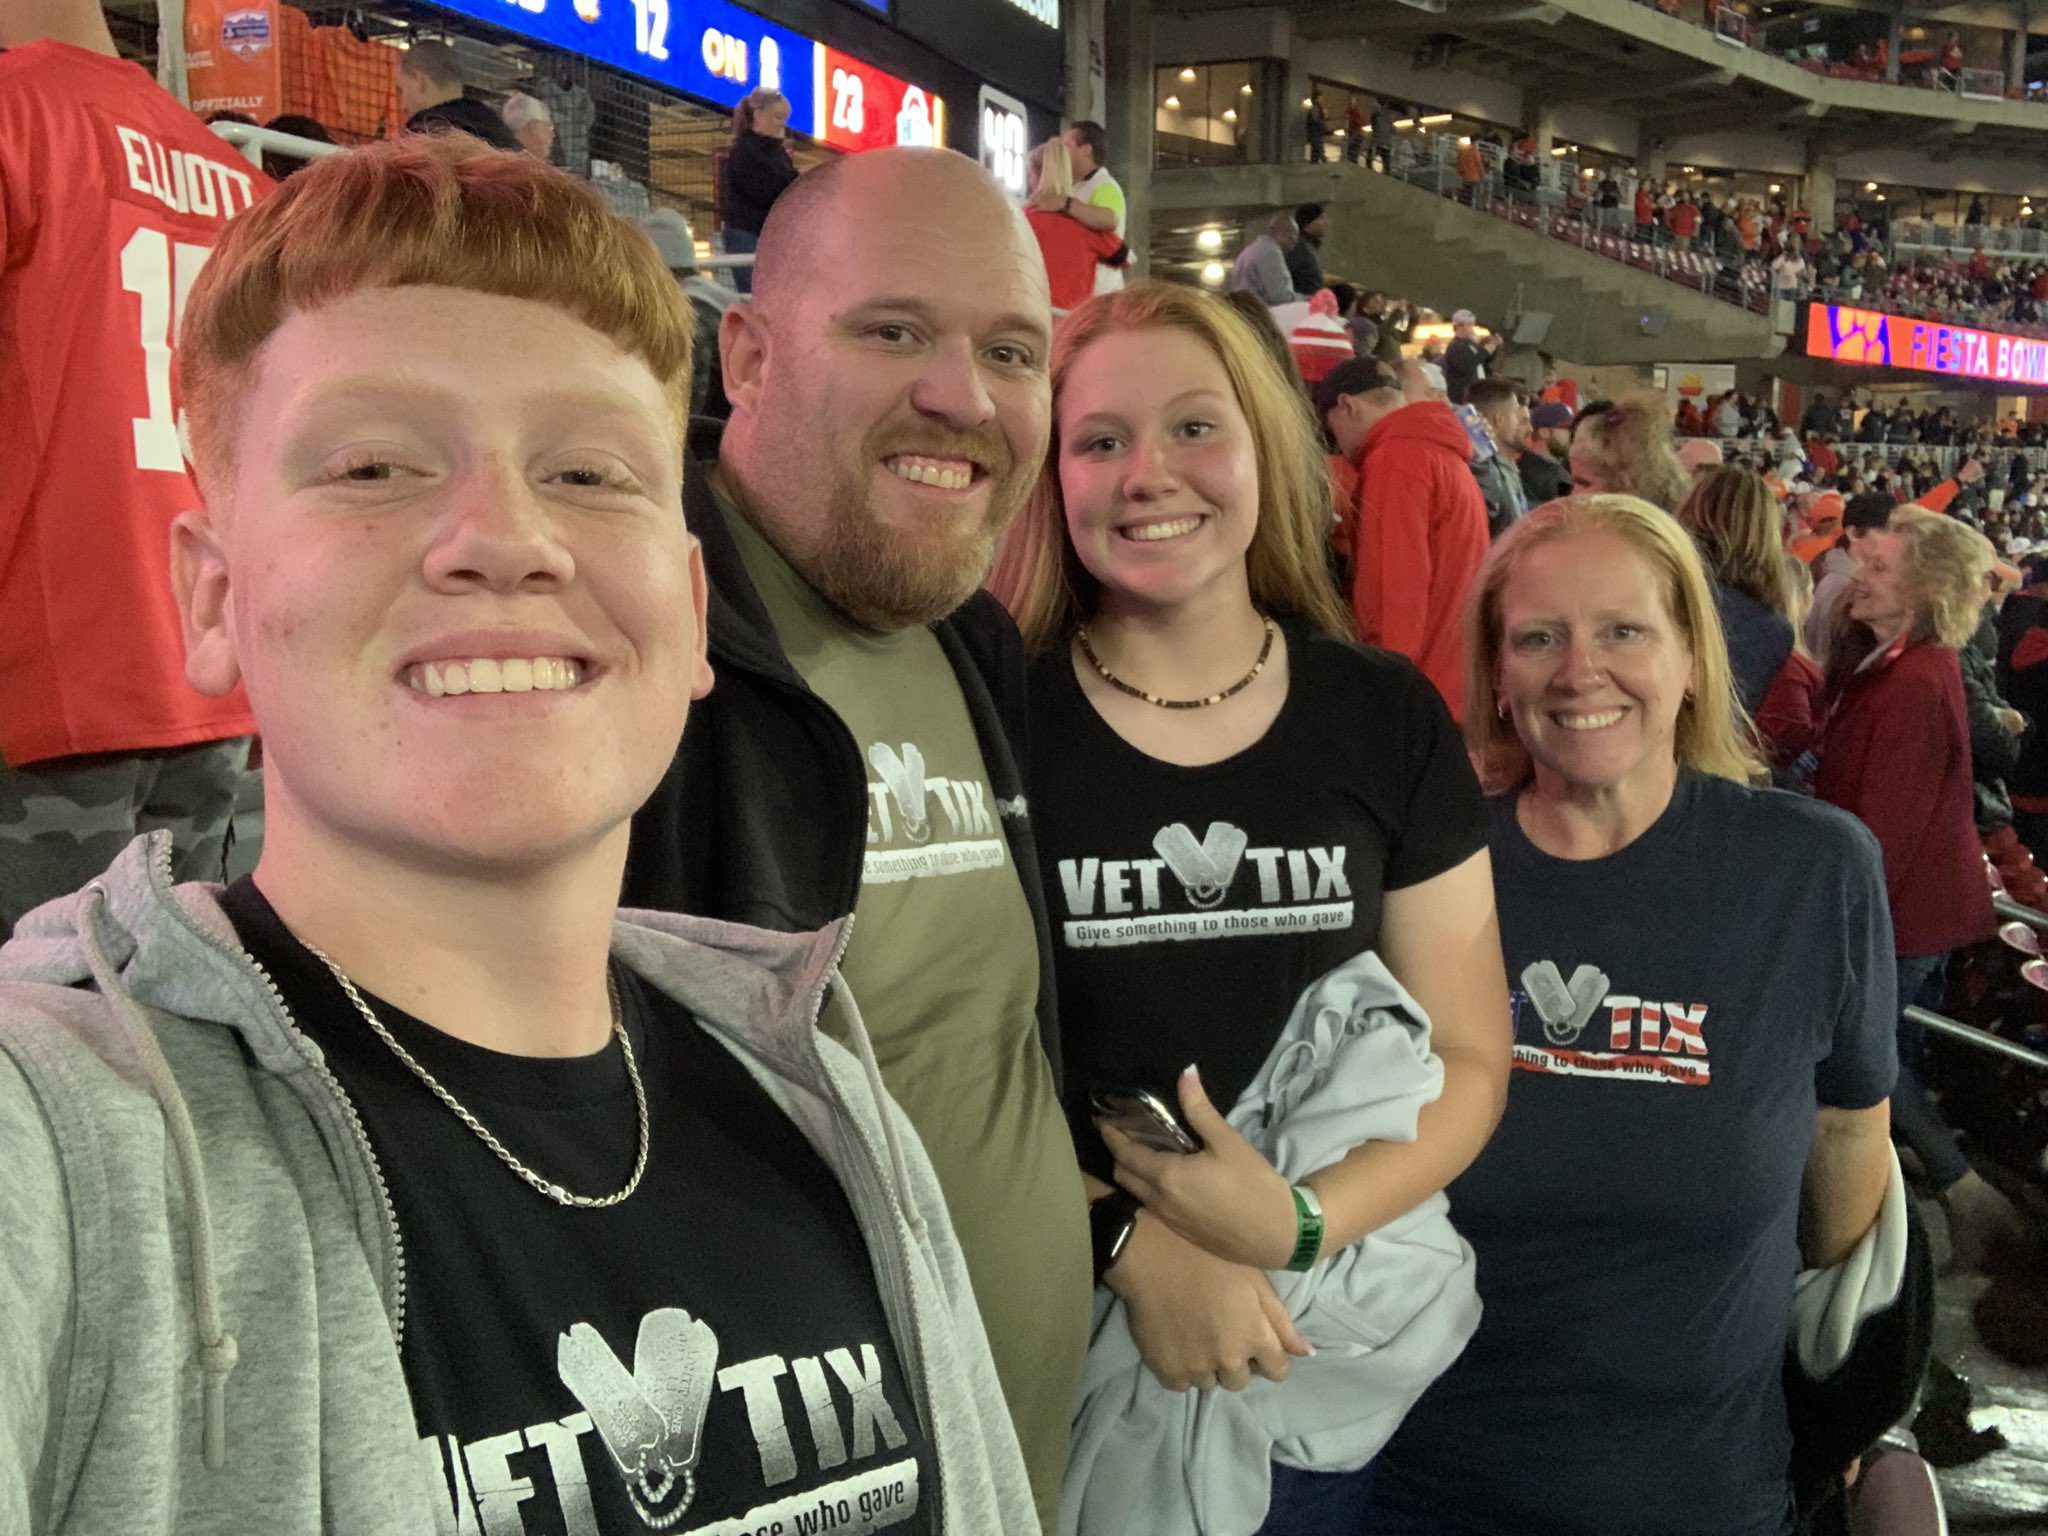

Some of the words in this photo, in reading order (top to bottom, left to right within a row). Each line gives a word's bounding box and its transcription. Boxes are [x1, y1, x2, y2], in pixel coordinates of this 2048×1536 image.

[702, 27, 747, 83] ON
[192, 96, 263, 112] OFFICIALLY
[116, 125, 254, 221] ELLIOTT
[1911, 325, 1989, 375] FIESTA
[923, 776, 994, 837] TIX
[875, 854, 929, 875] something
[1058, 857, 1166, 916] VET
[1245, 846, 1352, 903] TIX
[1076, 926, 1111, 940] Give
[1115, 920, 1198, 938] something
[1203, 919, 1218, 932] to
[1224, 915, 1269, 930] those
[1274, 912, 1307, 928] who
[1312, 911, 1344, 926] gave
[1602, 994, 1709, 1056] TIX
[1553, 1054, 1569, 1068] to
[1622, 1059, 1655, 1075] who
[1660, 1060, 1697, 1078] gave
[717, 1343, 908, 1488] TIX
[793, 1500, 851, 1536] who
[858, 1480, 904, 1522] gave
